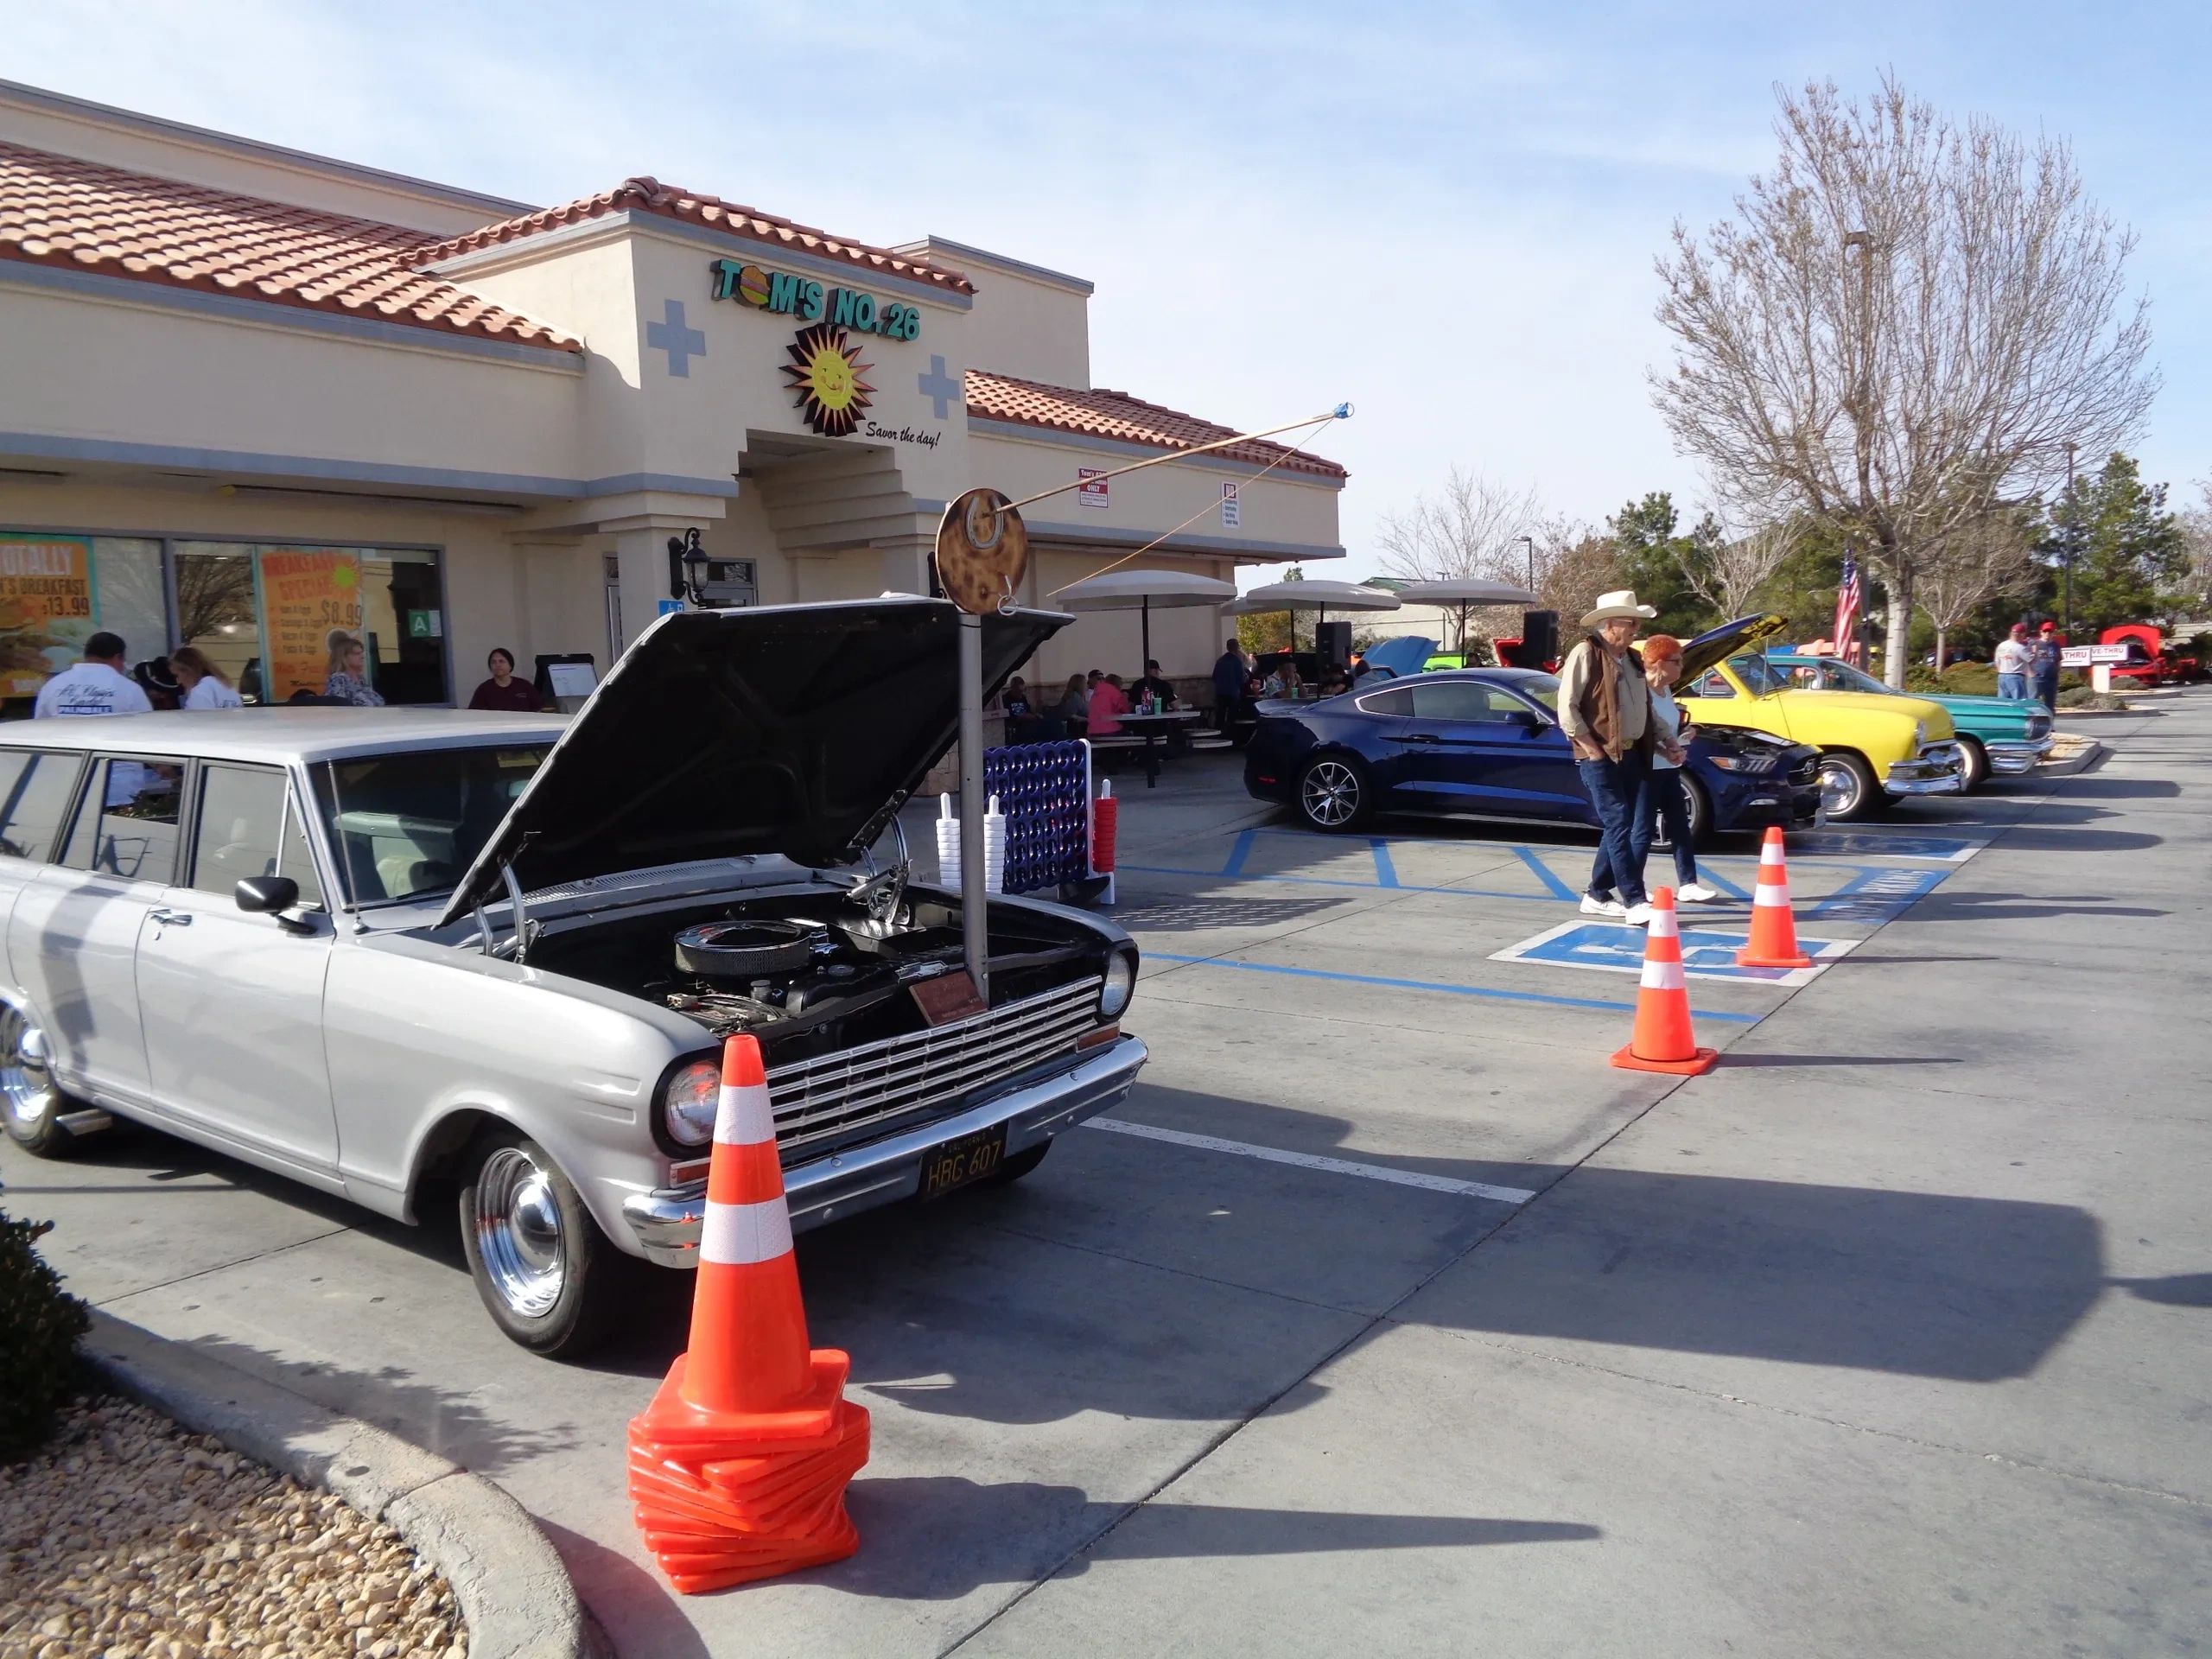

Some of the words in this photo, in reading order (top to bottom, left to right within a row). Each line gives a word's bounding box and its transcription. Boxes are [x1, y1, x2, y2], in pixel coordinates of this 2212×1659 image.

[718, 258, 823, 320] TOM'S
[833, 287, 882, 333] NO.
[887, 302, 921, 341] 26
[865, 421, 898, 441] Savor
[899, 426, 916, 443] the
[916, 429, 942, 450] day!
[1086, 484, 1101, 493] ONLY
[20, 577, 86, 596] BREAKFAST
[321, 599, 364, 626] $8.99
[414, 616, 427, 632] A
[969, 1140, 1001, 1175] 607
